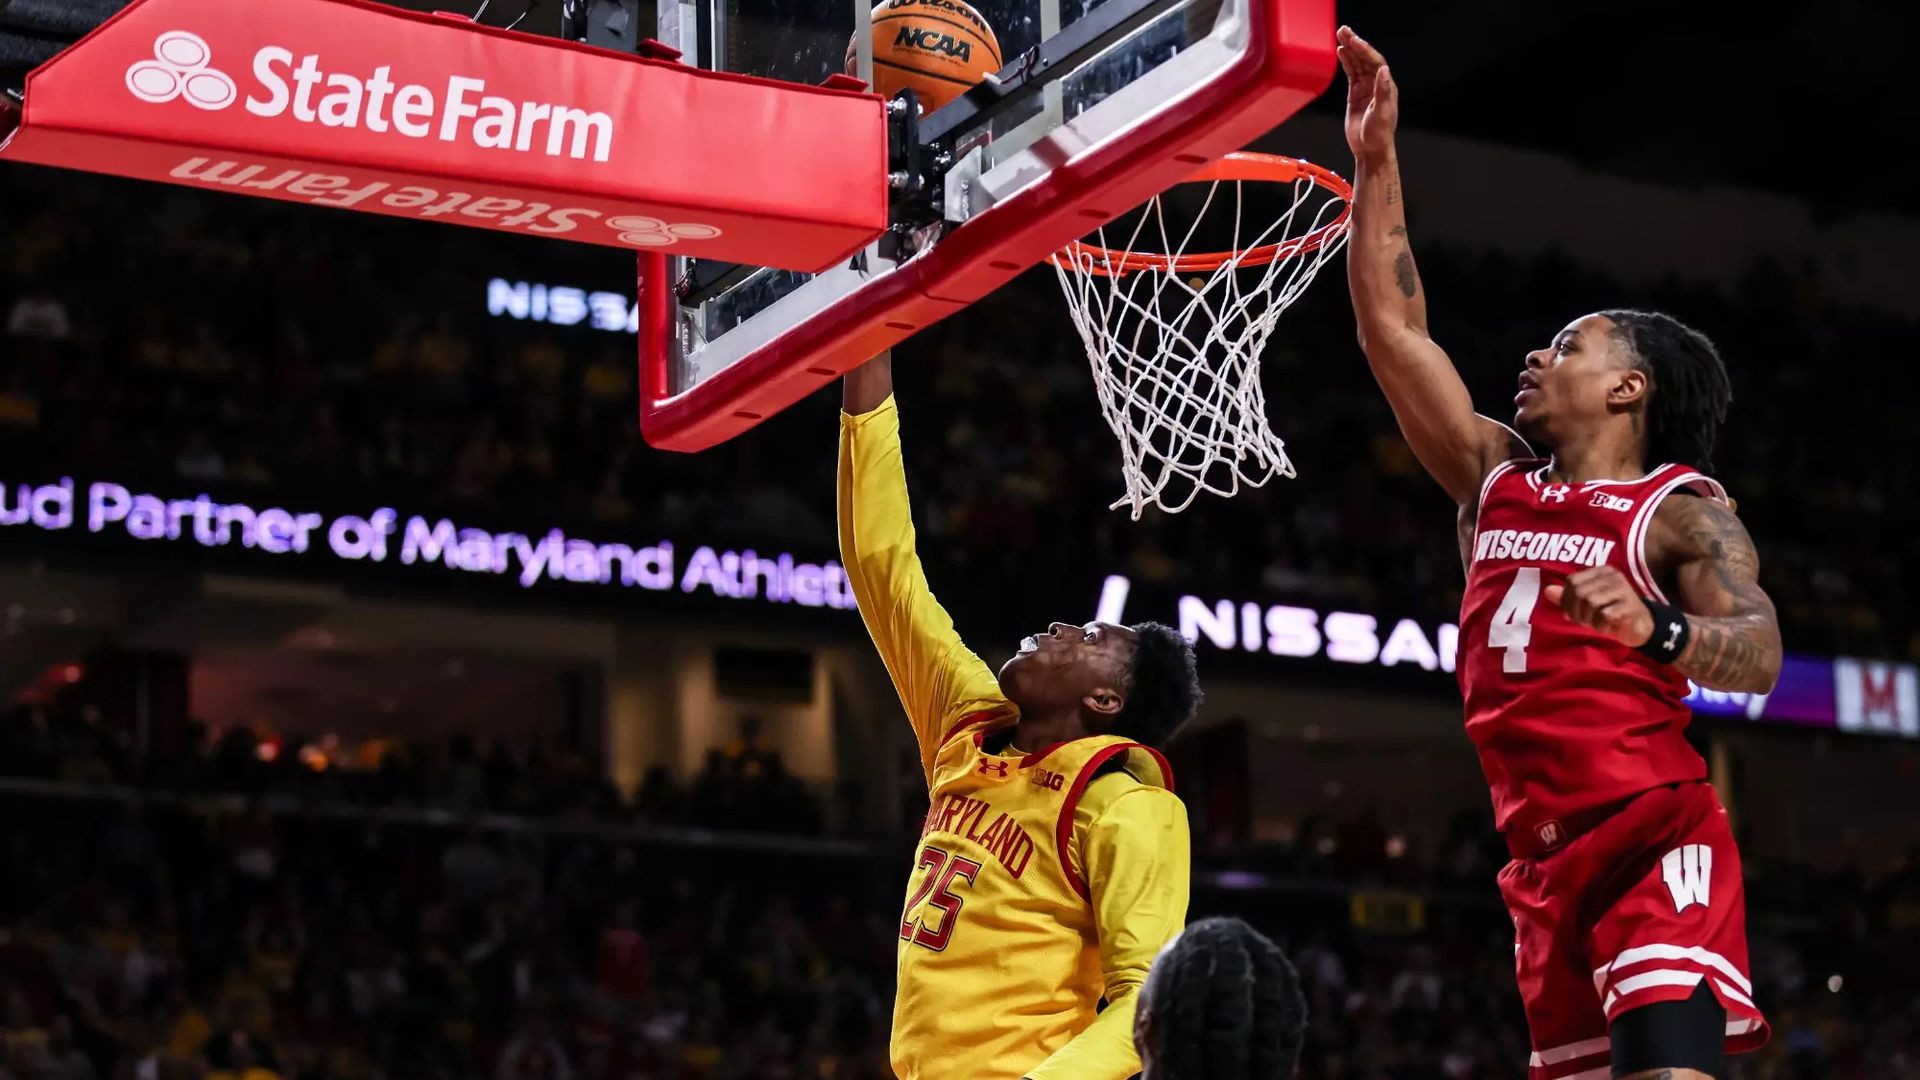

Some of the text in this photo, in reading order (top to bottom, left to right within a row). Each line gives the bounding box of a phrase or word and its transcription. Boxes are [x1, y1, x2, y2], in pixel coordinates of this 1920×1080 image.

[893, 26, 971, 63] NCAA
[486, 277, 639, 334] NISS
[88, 482, 323, 554] Partner
[328, 507, 397, 562] of
[400, 514, 674, 590] Maryland
[1475, 529, 1617, 567] WISCONSIN
[1487, 566, 1541, 673] 4
[900, 845, 983, 952] 25
[1661, 843, 1713, 915] W
